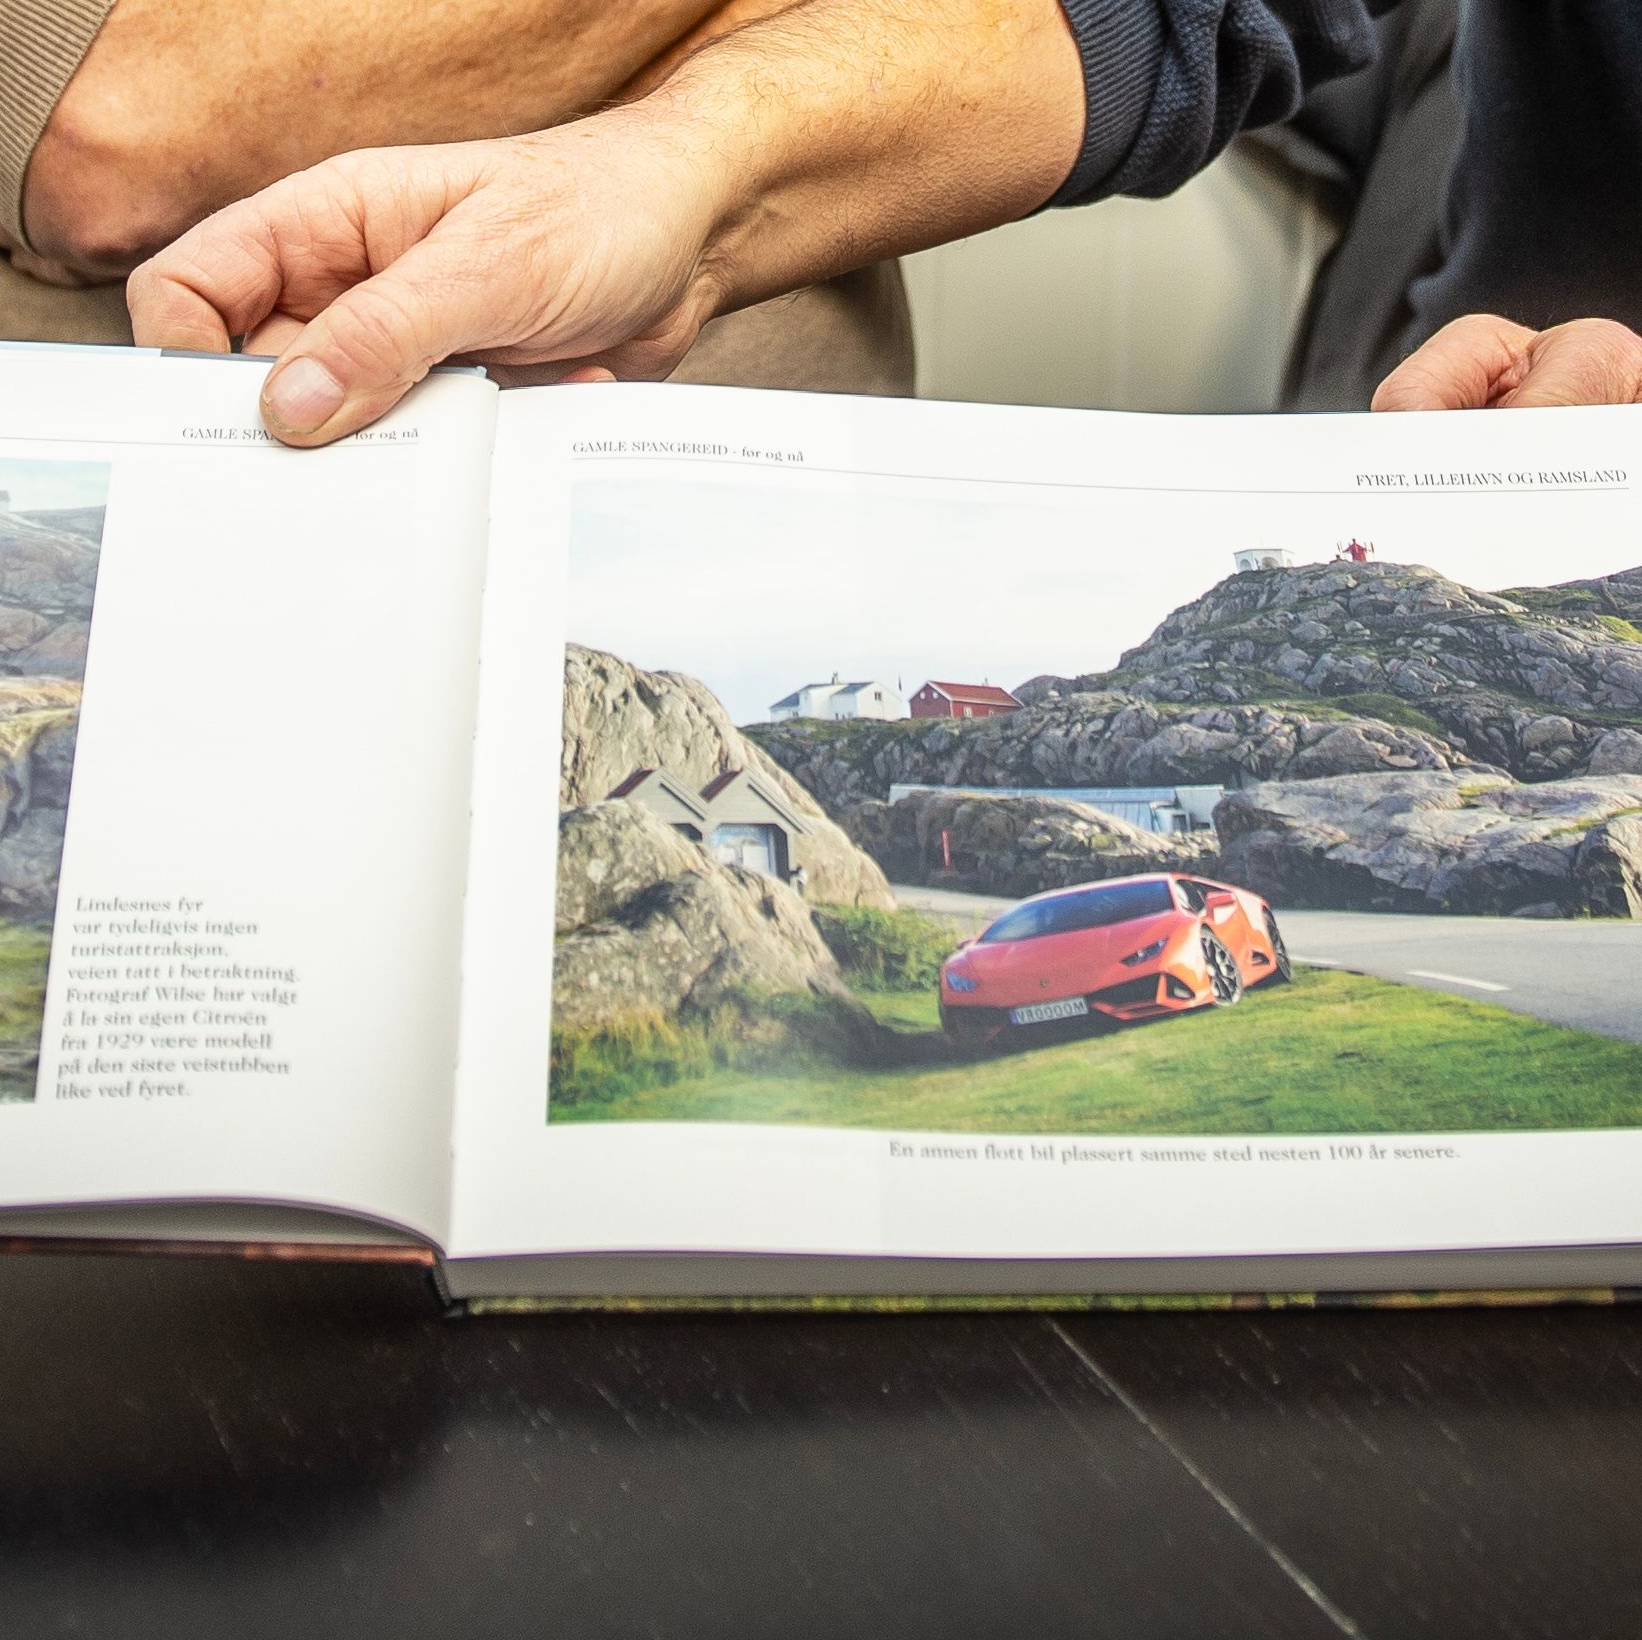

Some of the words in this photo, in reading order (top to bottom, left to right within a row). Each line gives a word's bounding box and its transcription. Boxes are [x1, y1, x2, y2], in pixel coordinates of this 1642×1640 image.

[181, 426, 238, 441] GAMLE
[379, 430, 397, 441] og
[402, 426, 419, 439] nå
[571, 440, 628, 454] GAMLE
[630, 440, 729, 457] SPANGEREID
[765, 450, 783, 463] og
[787, 449, 805, 463] nå
[1356, 473, 1410, 488] FYRET,
[1413, 472, 1504, 487] LILLEHAVN
[1507, 471, 1534, 485] OG
[1537, 469, 1628, 484] RAMSLAND
[75, 897, 171, 913] Lindesnes
[177, 897, 205, 916] fyr
[72, 921, 102, 935] var
[108, 919, 199, 938] tydeligvis
[205, 920, 258, 937] ingen
[67, 965, 119, 980] veien
[125, 964, 161, 980] tatt
[65, 986, 151, 1005] Fotograf
[156, 986, 206, 1002] Wilse
[213, 986, 245, 1002] har
[251, 987, 298, 1006] valgt
[80, 1010, 97, 1026] la
[103, 1010, 133, 1026] sin
[138, 1012, 186, 1028] egen
[192, 1009, 268, 1026] Citroën
[60, 1034, 87, 1051] fra
[96, 1033, 145, 1050] 1929
[150, 1035, 199, 1050] være
[204, 1032, 273, 1050] modell
[57, 1059, 81, 1079] på
[87, 1058, 124, 1075] den
[130, 1058, 177, 1074] siste
[182, 1057, 291, 1075] veistubben
[55, 1082, 93, 1100] like
[98, 1080, 132, 1098] ved
[138, 1079, 192, 1100] fyret.
[888, 1140, 915, 1158] En
[920, 1143, 978, 1159] annen
[984, 1143, 1025, 1160] flott
[1031, 1144, 1056, 1161] bil
[1061, 1144, 1134, 1165] plassert
[1140, 1147, 1207, 1162] samme
[1213, 1145, 1253, 1162] sted
[1258, 1146, 1321, 1162] nesten
[1329, 1144, 1363, 1161] 100
[1369, 1143, 1387, 1161] år
[1393, 1146, 1461, 1160] senere.
